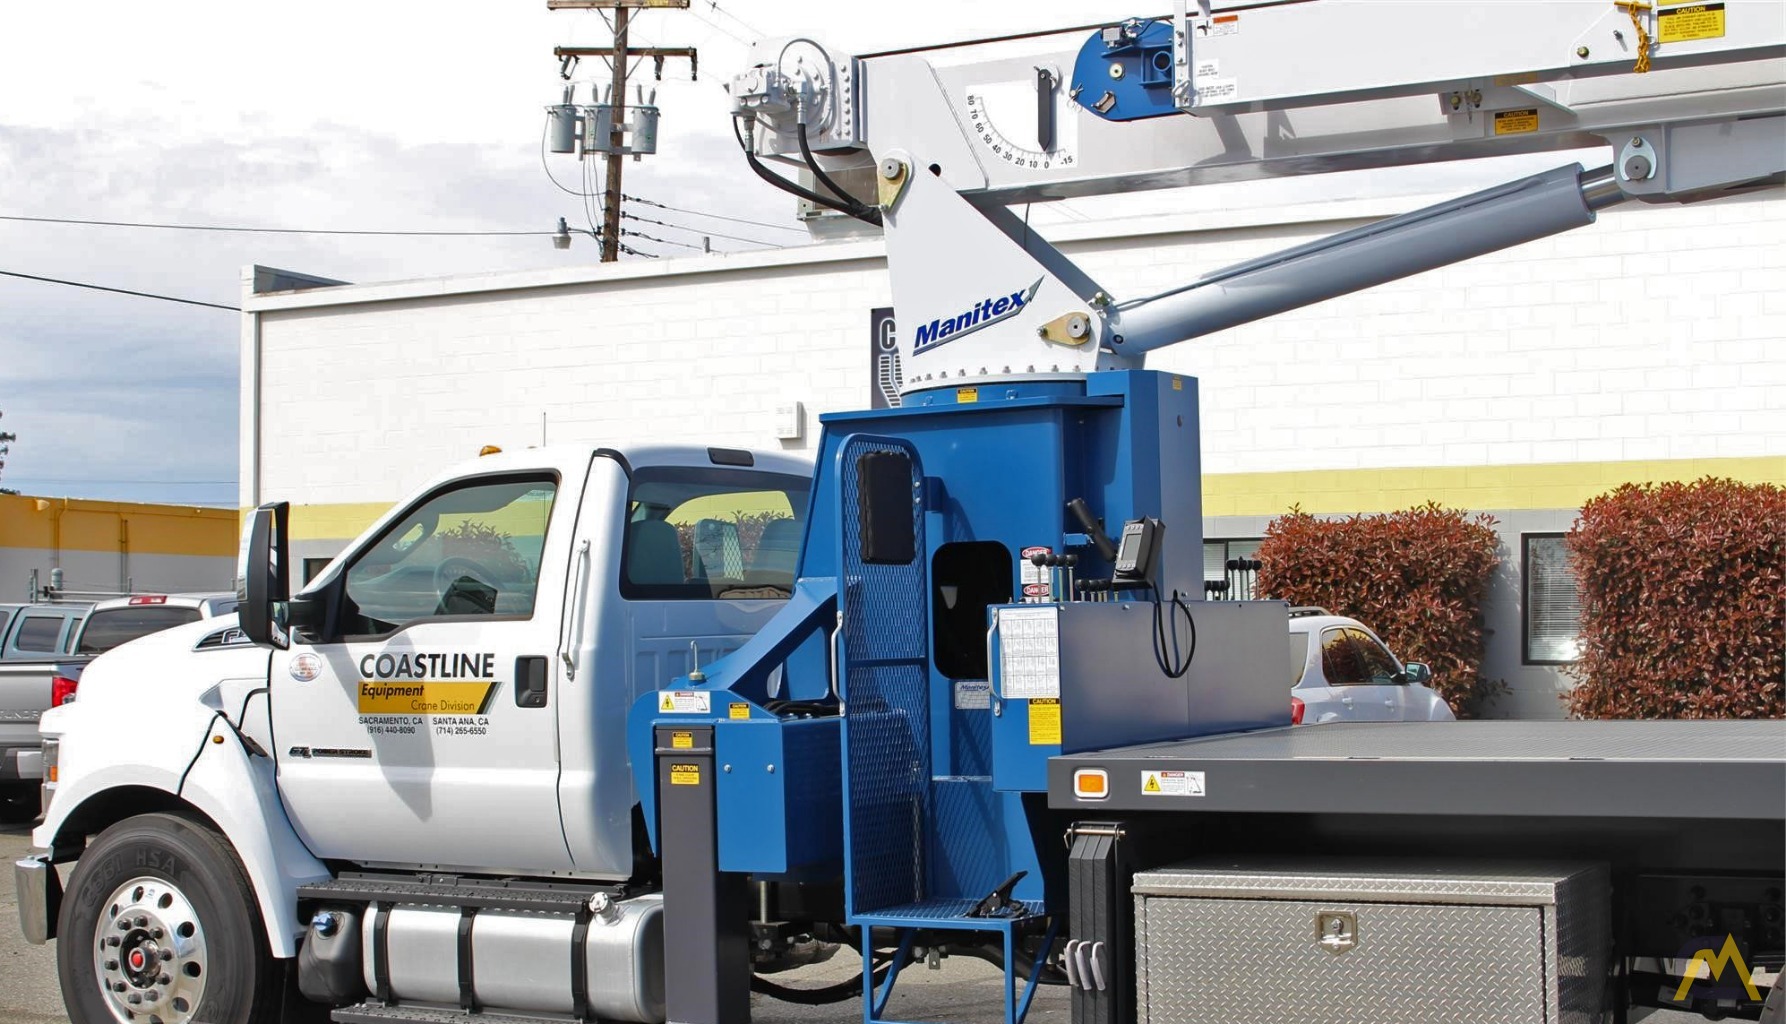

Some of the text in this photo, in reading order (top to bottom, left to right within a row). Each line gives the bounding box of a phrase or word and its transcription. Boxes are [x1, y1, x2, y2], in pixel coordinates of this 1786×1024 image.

[1676, 6, 1706, 14] CAUTION
[967, 95, 975, 106] 80
[970, 109, 979, 120] 70
[1503, 110, 1529, 118] CAUTION
[975, 122, 984, 133] 60
[983, 134, 993, 145] 50
[992, 144, 1002, 154] 40
[1002, 151, 1013, 161] 30
[1060, 155, 1073, 165] -15
[1015, 157, 1025, 166] 20
[1029, 160, 1038, 168] 10
[1044, 161, 1050, 169] 0
[914, 288, 1027, 348] Manitex
[360, 653, 495, 679] COASTLINE
[361, 683, 425, 700] Equipment
[410, 700, 475, 711] Crane Division
[358, 717, 423, 726] SACRAMENTO, CA
[432, 717, 489, 727] SANTA ANA, CA
[367, 726, 416, 735] (916) 440-8090
[436, 726, 454, 735] (714)
[136, 850, 177, 874] HSA
